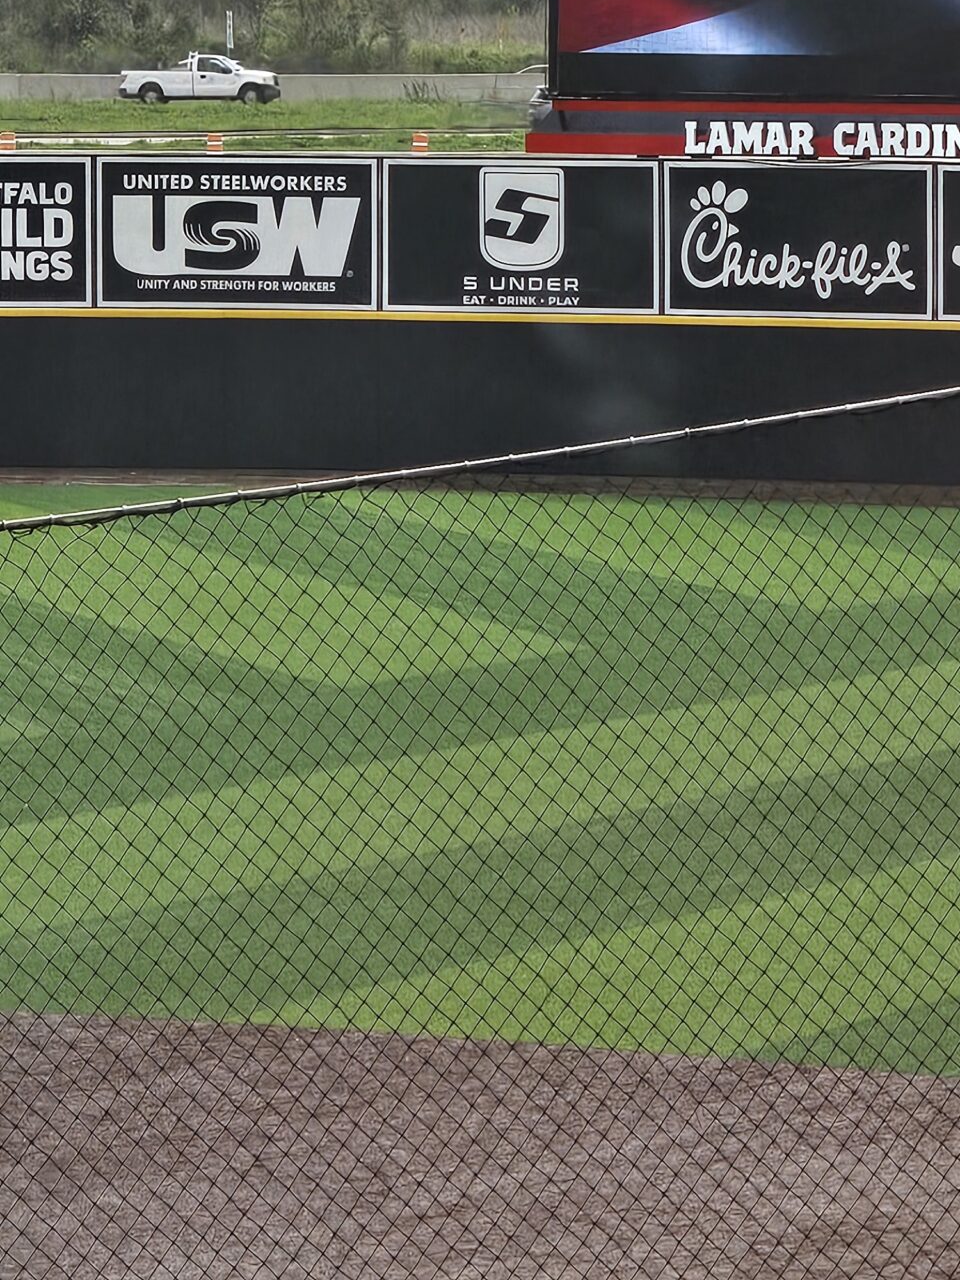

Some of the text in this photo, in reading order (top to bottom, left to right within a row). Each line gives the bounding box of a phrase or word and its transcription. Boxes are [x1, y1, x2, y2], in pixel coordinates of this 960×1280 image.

[684, 120, 815, 156] LAMAR
[123, 174, 347, 192] UNITED STEELWORKERS
[0, 182, 73, 205] FALO
[112, 195, 361, 277] USW
[681, 206, 916, 300] Chick-fil-A
[136, 279, 336, 292] UNITY AND STRENGTH FOR WORKERS
[490, 277, 579, 292] UNDER
[463, 296, 580, 307] EAT DRINK PLAY
